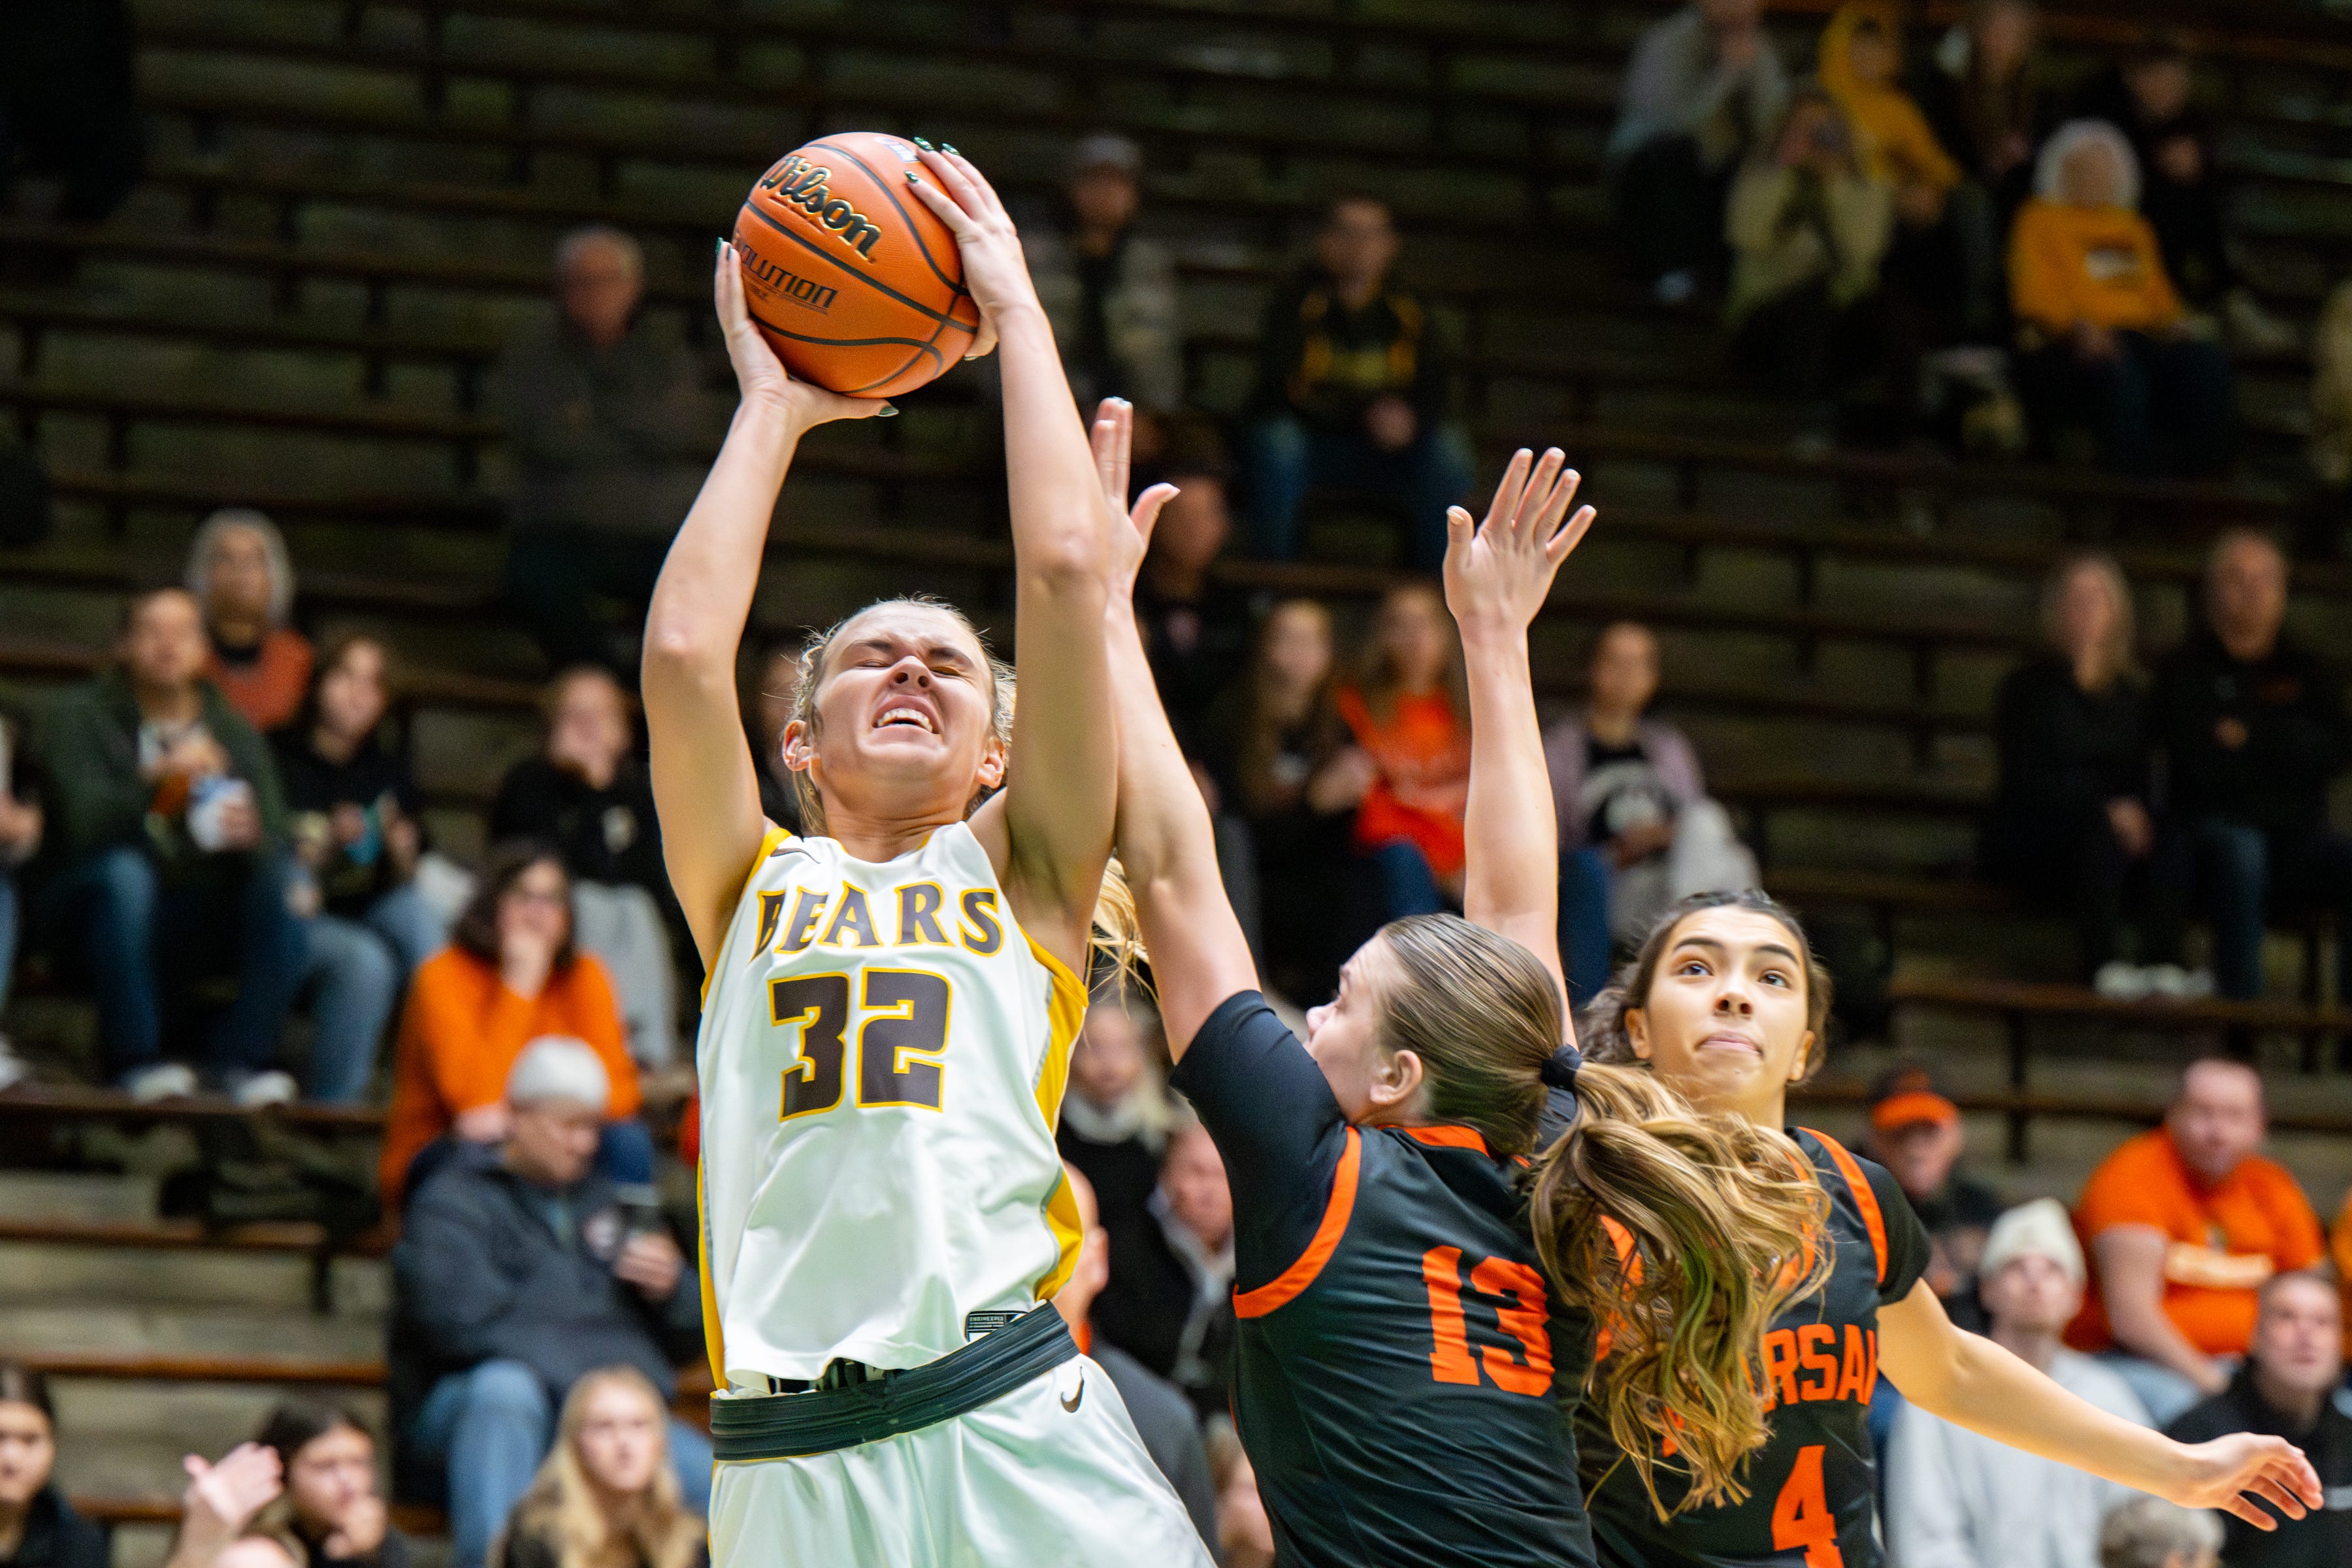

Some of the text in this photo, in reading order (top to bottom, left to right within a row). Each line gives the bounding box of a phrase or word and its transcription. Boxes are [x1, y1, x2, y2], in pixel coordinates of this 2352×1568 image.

[760, 155, 882, 261] Wilson
[747, 880, 1004, 966] BEARS
[767, 966, 953, 1123] 32
[1422, 1245, 1556, 1398] 13
[1771, 1445, 1844, 1568] 4
